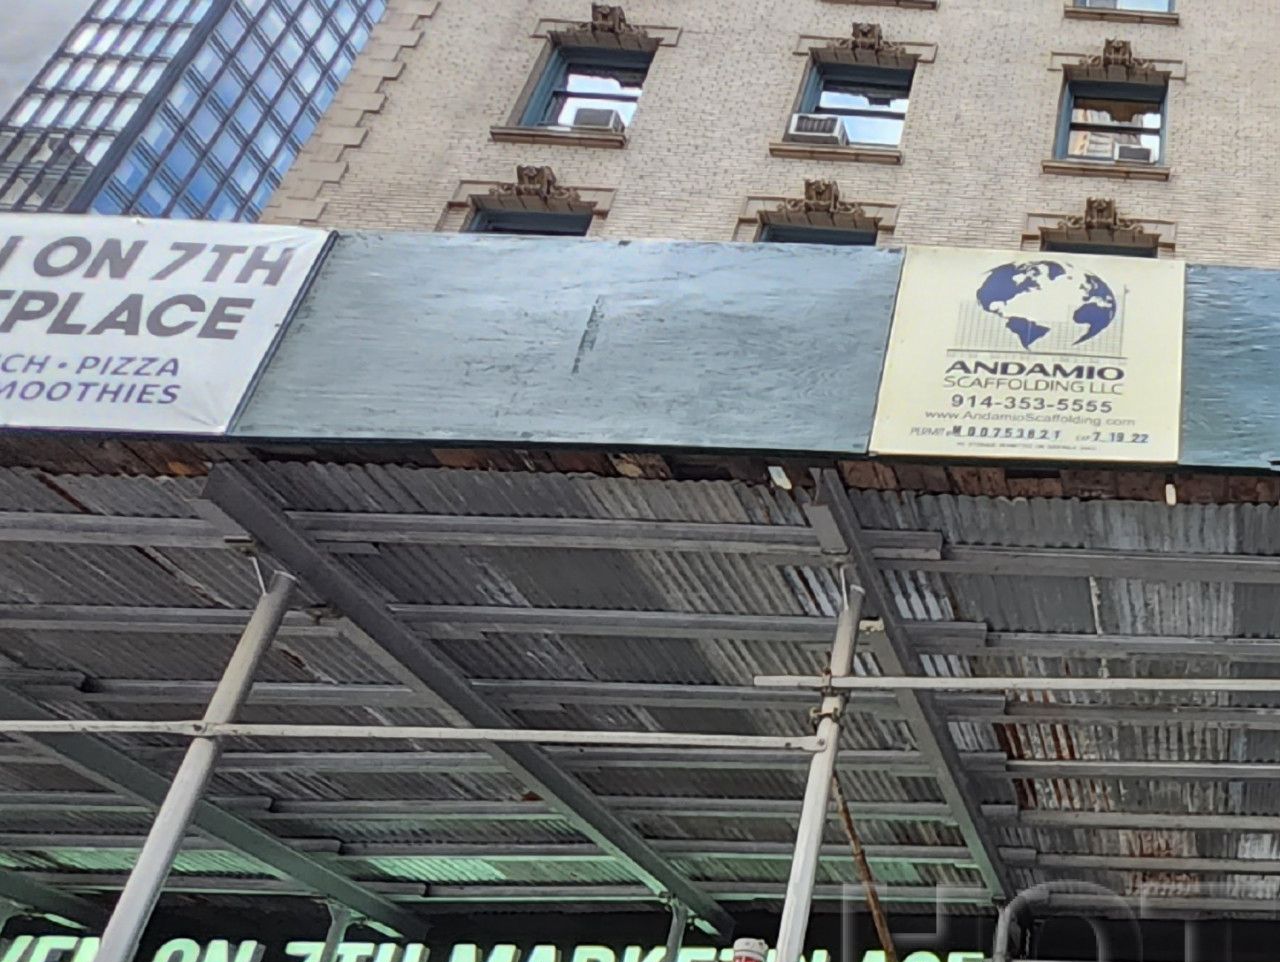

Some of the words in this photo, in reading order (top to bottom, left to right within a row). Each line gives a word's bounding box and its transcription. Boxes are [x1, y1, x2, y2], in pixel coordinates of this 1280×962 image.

[33, 236, 148, 279] ON
[150, 242, 294, 286] 7TH
[76, 356, 180, 377] PIZZA
[945, 360, 1125, 381] ANDAMIO
[943, 375, 1085, 394] SCAFFOLDING
[1089, 382, 1124, 396] LLC
[951, 394, 1113, 413] 914-353-5555
